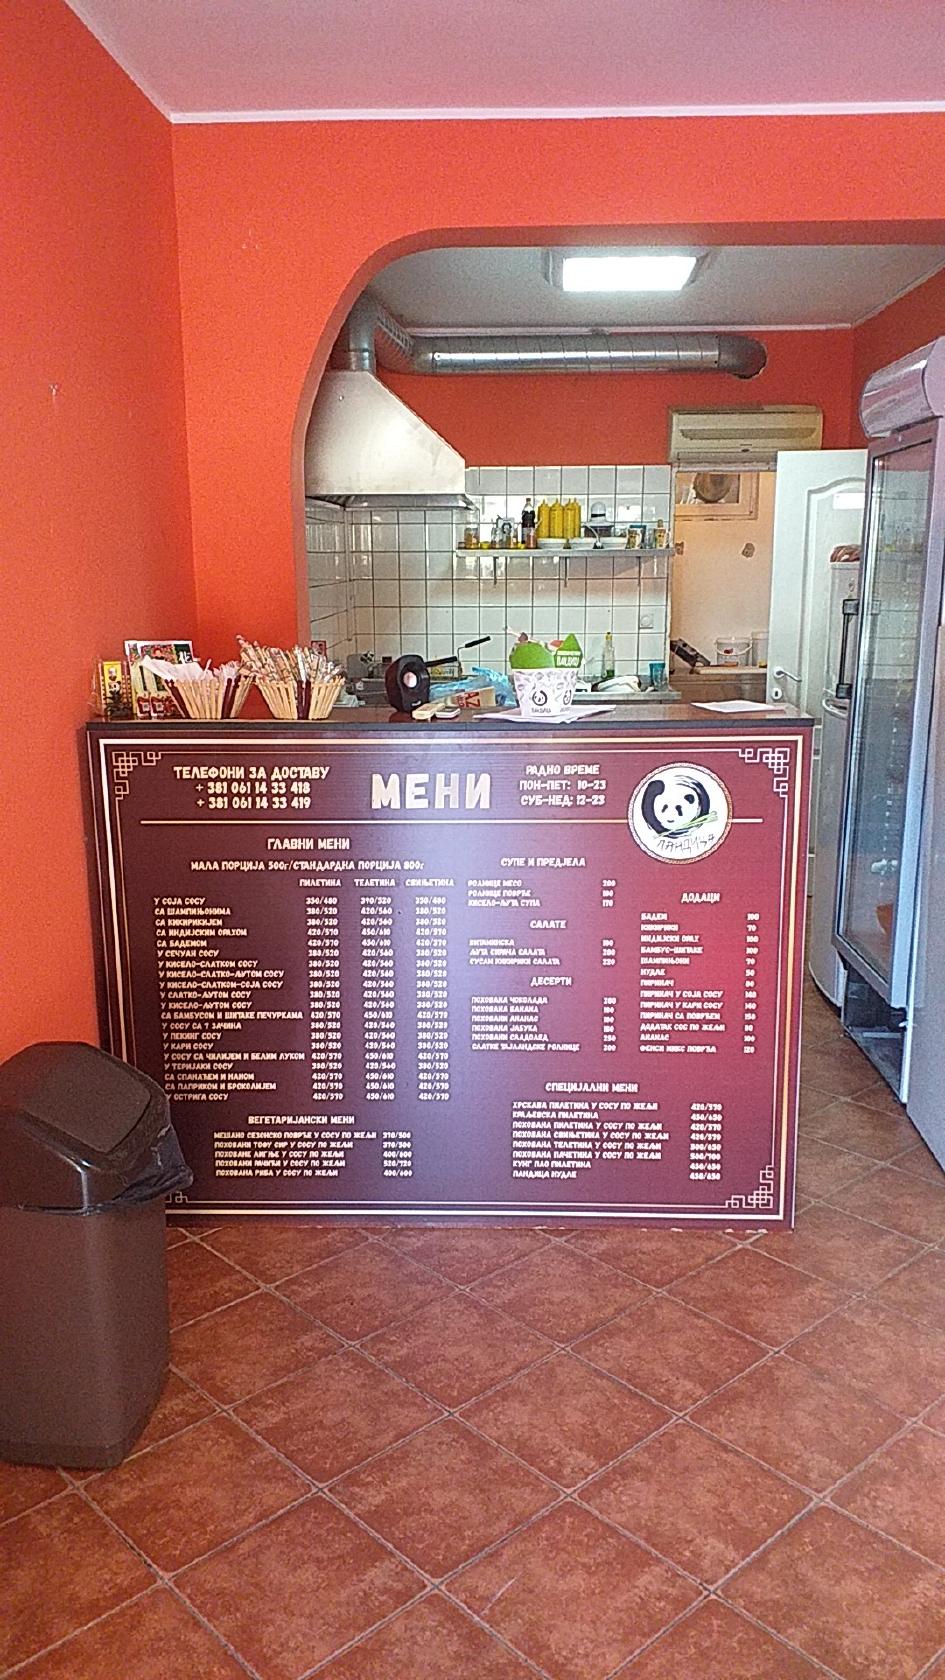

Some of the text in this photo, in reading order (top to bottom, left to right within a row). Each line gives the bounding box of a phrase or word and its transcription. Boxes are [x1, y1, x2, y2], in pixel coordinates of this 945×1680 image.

[174, 766, 329, 780] ТЕЛЕФОНИ ЗА ДОСТАВУ
[526, 765, 599, 776] РАДНО ВРЕМЕ
[208, 782, 227, 794] 381
[231, 782, 250, 794] 061
[255, 782, 267, 794] 14
[272, 782, 286, 794] 33
[291, 782, 310, 794] 418
[520, 780, 606, 790] ПОН-ПЕТ: 10-23
[372, 773, 490, 809] МЕНИ
[209, 797, 228, 808] 381
[232, 797, 252, 808] 061
[256, 797, 268, 808] 14
[272, 797, 287, 808] 33
[291, 797, 311, 808] 419
[520, 795, 605, 807] СУБ-НЕД: 12-23
[268, 838, 349, 849] ГЛАВНИ МЕНИ
[191, 861, 219, 870] МАЛА
[222, 861, 265, 871] ПОРЦИЈА
[358, 860, 402, 872] ПОРЦИЈА
[501, 857, 585, 868] СУПЕ И ПРЕДЈЕЛА
[681, 893, 720, 903] ДОДАЦИ
[530, 920, 566, 928] САЛАТЕ
[530, 977, 571, 986] ДЕСЕРТИ
[546, 1082, 638, 1092] СПЕЦИЈАЛНИ МЕНИ
[248, 1116, 354, 1124] ВЕГЕТАРИЈАНСКИ МЕНИ
